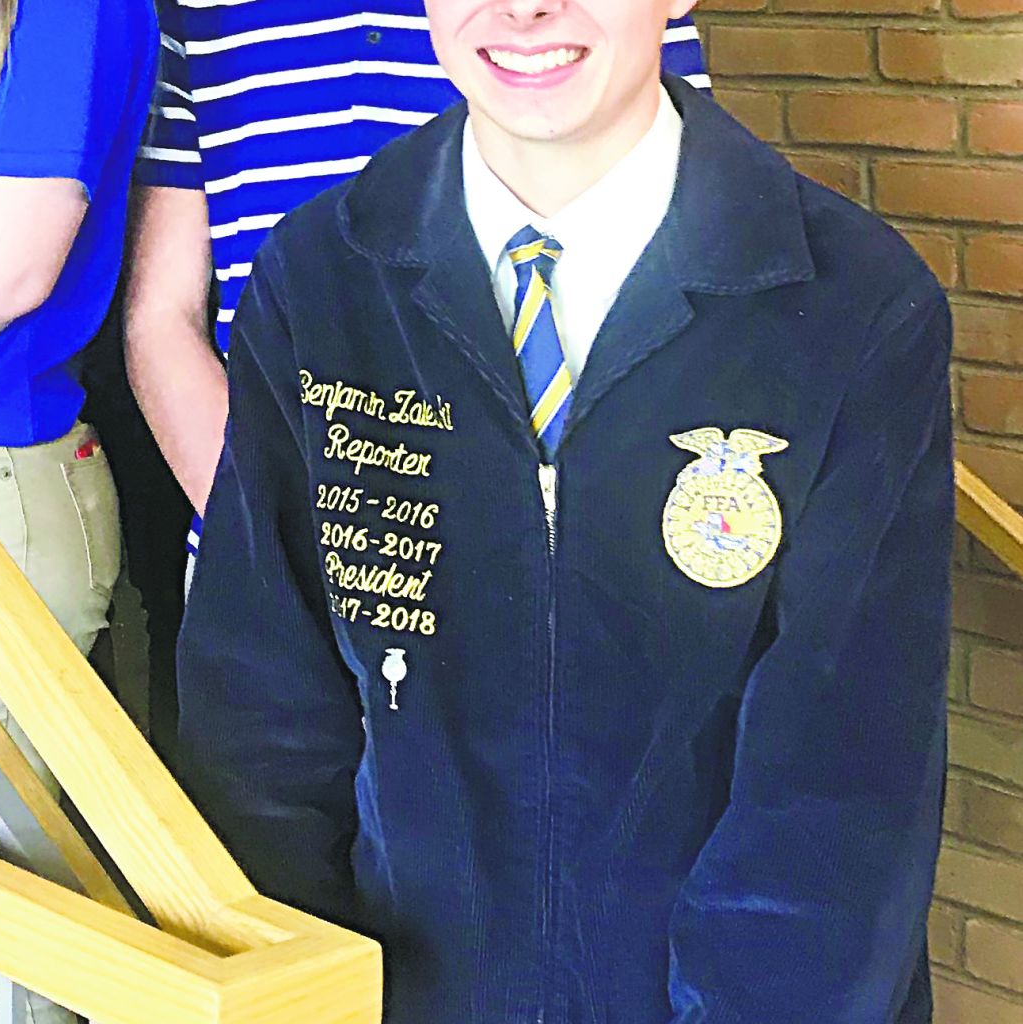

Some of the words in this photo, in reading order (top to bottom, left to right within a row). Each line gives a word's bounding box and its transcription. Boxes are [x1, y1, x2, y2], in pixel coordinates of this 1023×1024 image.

[299, 369, 386, 421] Benjamin
[324, 423, 432, 476] Reporter
[702, 494, 741, 513] FFA
[325, 551, 433, 601] President
